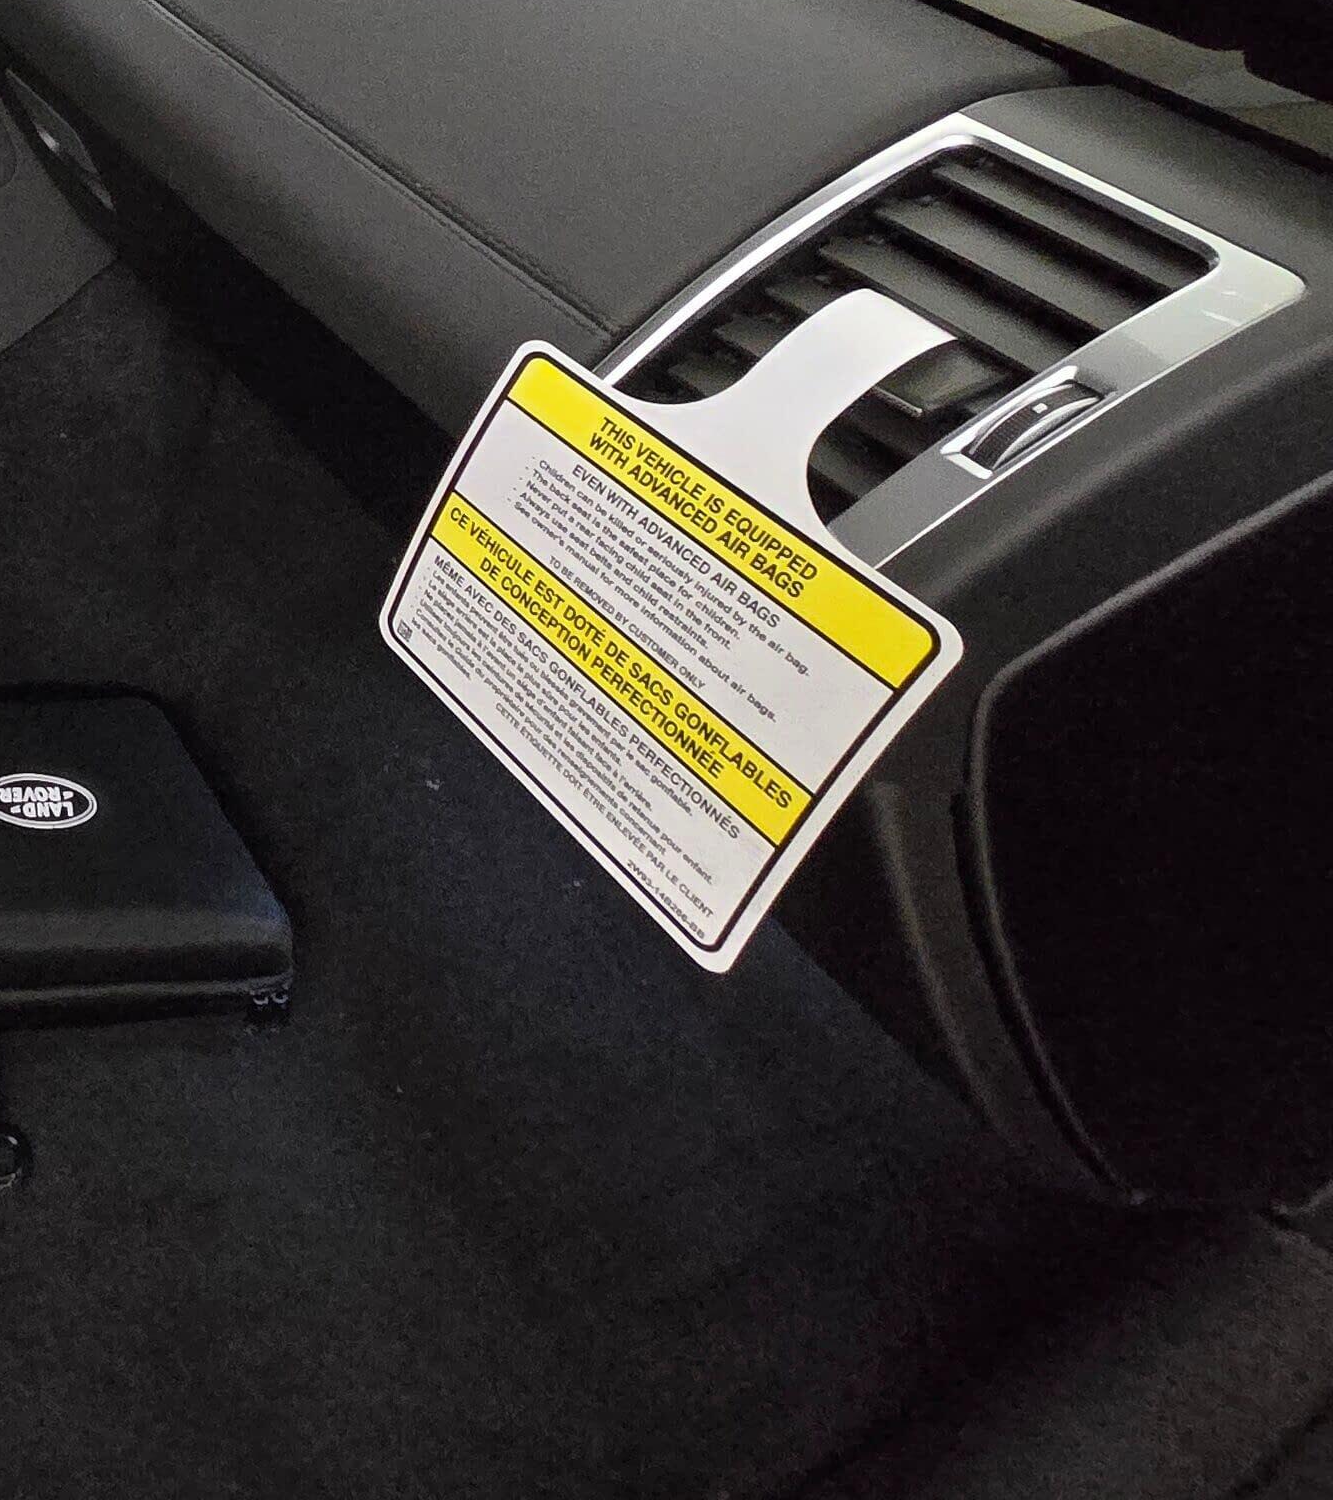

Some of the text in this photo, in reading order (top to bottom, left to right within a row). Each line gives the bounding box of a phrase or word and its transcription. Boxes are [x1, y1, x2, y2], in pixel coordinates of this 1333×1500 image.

[518, 489, 711, 650] Always use seat belts and child restraints.
[525, 479, 733, 650] Never put a rear facing child seat in the front.
[530, 468, 743, 640] The back seat is the safest place for children.
[537, 458, 813, 679] Children can be killed or seriously injured by the air bag.
[571, 463, 781, 629] EVEN WITH ADVANCED AIR BAGS
[587, 432, 806, 600] WITH ADVANCED AIR BAGS
[597, 416, 820, 584] THIS VEHICLE IS EQUIPPED
[448, 505, 794, 811] CE VÉHICULE EST DOTÉ DE SACS GONFLABLES
[478, 556, 725, 780] DE CONCEPTION PERFECTIONNÉE
[513, 499, 779, 725] See owner's manual for more information about air bags.
[547, 555, 706, 691] TO BE REMOVED BY CUSTOMER ONLY
[432, 554, 742, 841] MÊME AVEC DES SACS GONFLABLES PERFECTIONNÉS
[528, 660, 540, 673] ou
[608, 736, 625, 754] par
[633, 758, 651, 777] sac
[557, 703, 578, 725] pour
[0, 787, 60, 803] ROVER
[23, 802, 74, 817] LAND
[494, 700, 521, 729] CETTE
[561, 767, 583, 791] DOIT
[644, 849, 666, 873] PAR
[664, 869, 679, 886] LE
[676, 881, 714, 920] CLIENT
[658, 832, 682, 857] pour
